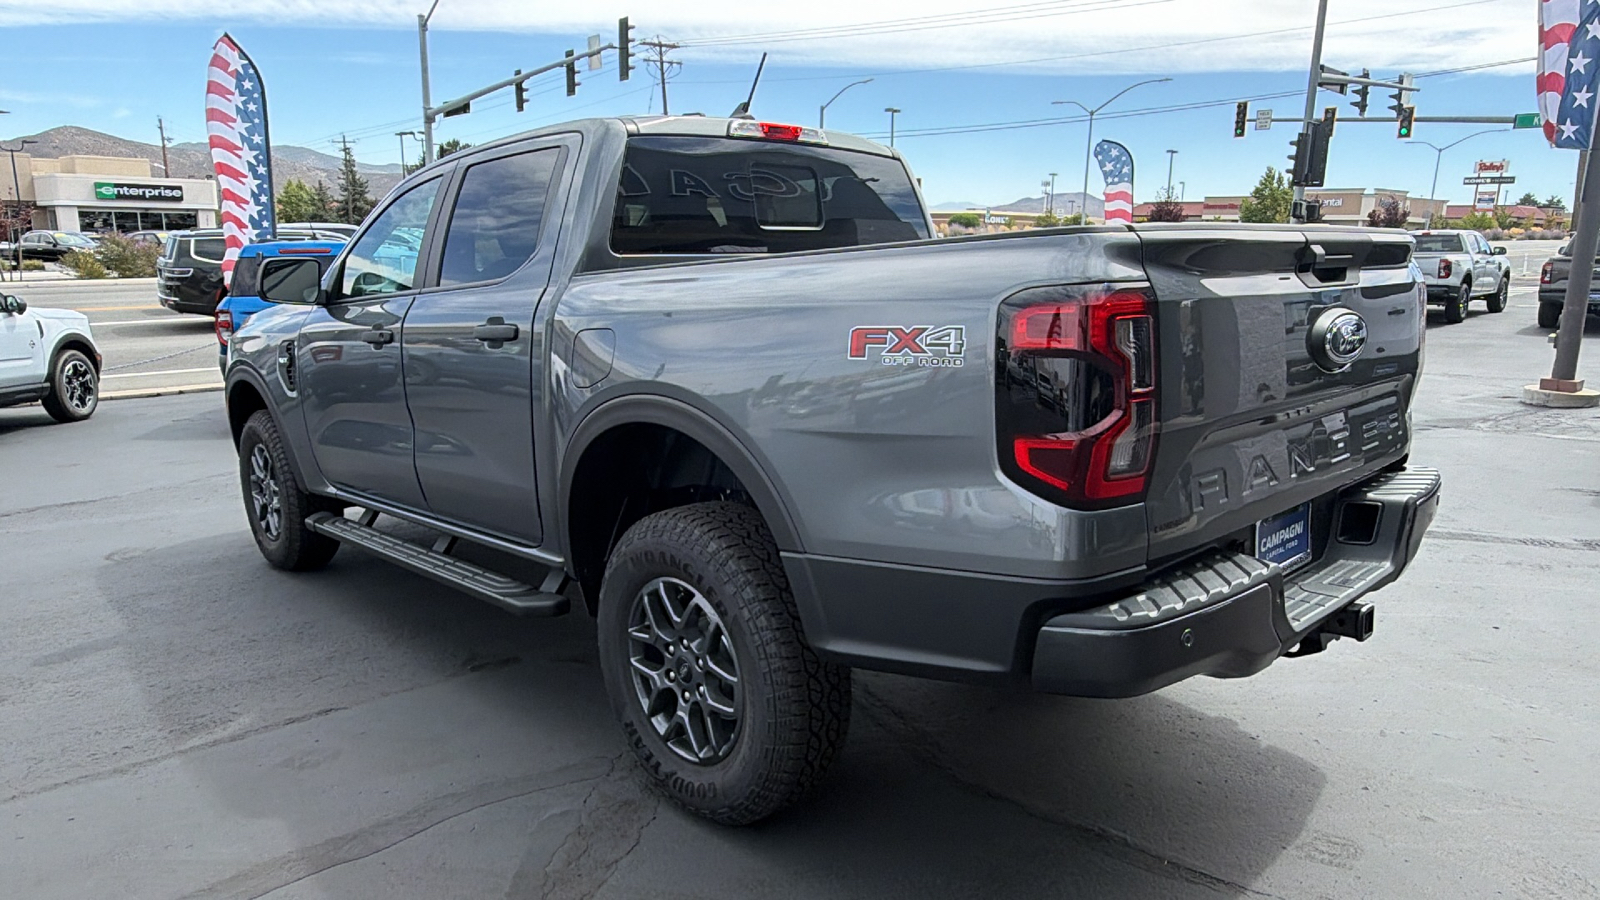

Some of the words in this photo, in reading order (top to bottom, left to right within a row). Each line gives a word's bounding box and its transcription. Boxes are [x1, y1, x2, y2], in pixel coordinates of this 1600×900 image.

[1478, 162, 1505, 172] Raley's
[96, 186, 182, 198] enterprise
[1321, 197, 1342, 208] ental
[848, 325, 966, 360] FX4
[881, 356, 914, 366] OFF
[919, 357, 964, 368] ROAD
[1260, 520, 1304, 552] CAMPAGNI
[1285, 539, 1298, 550] FORD
